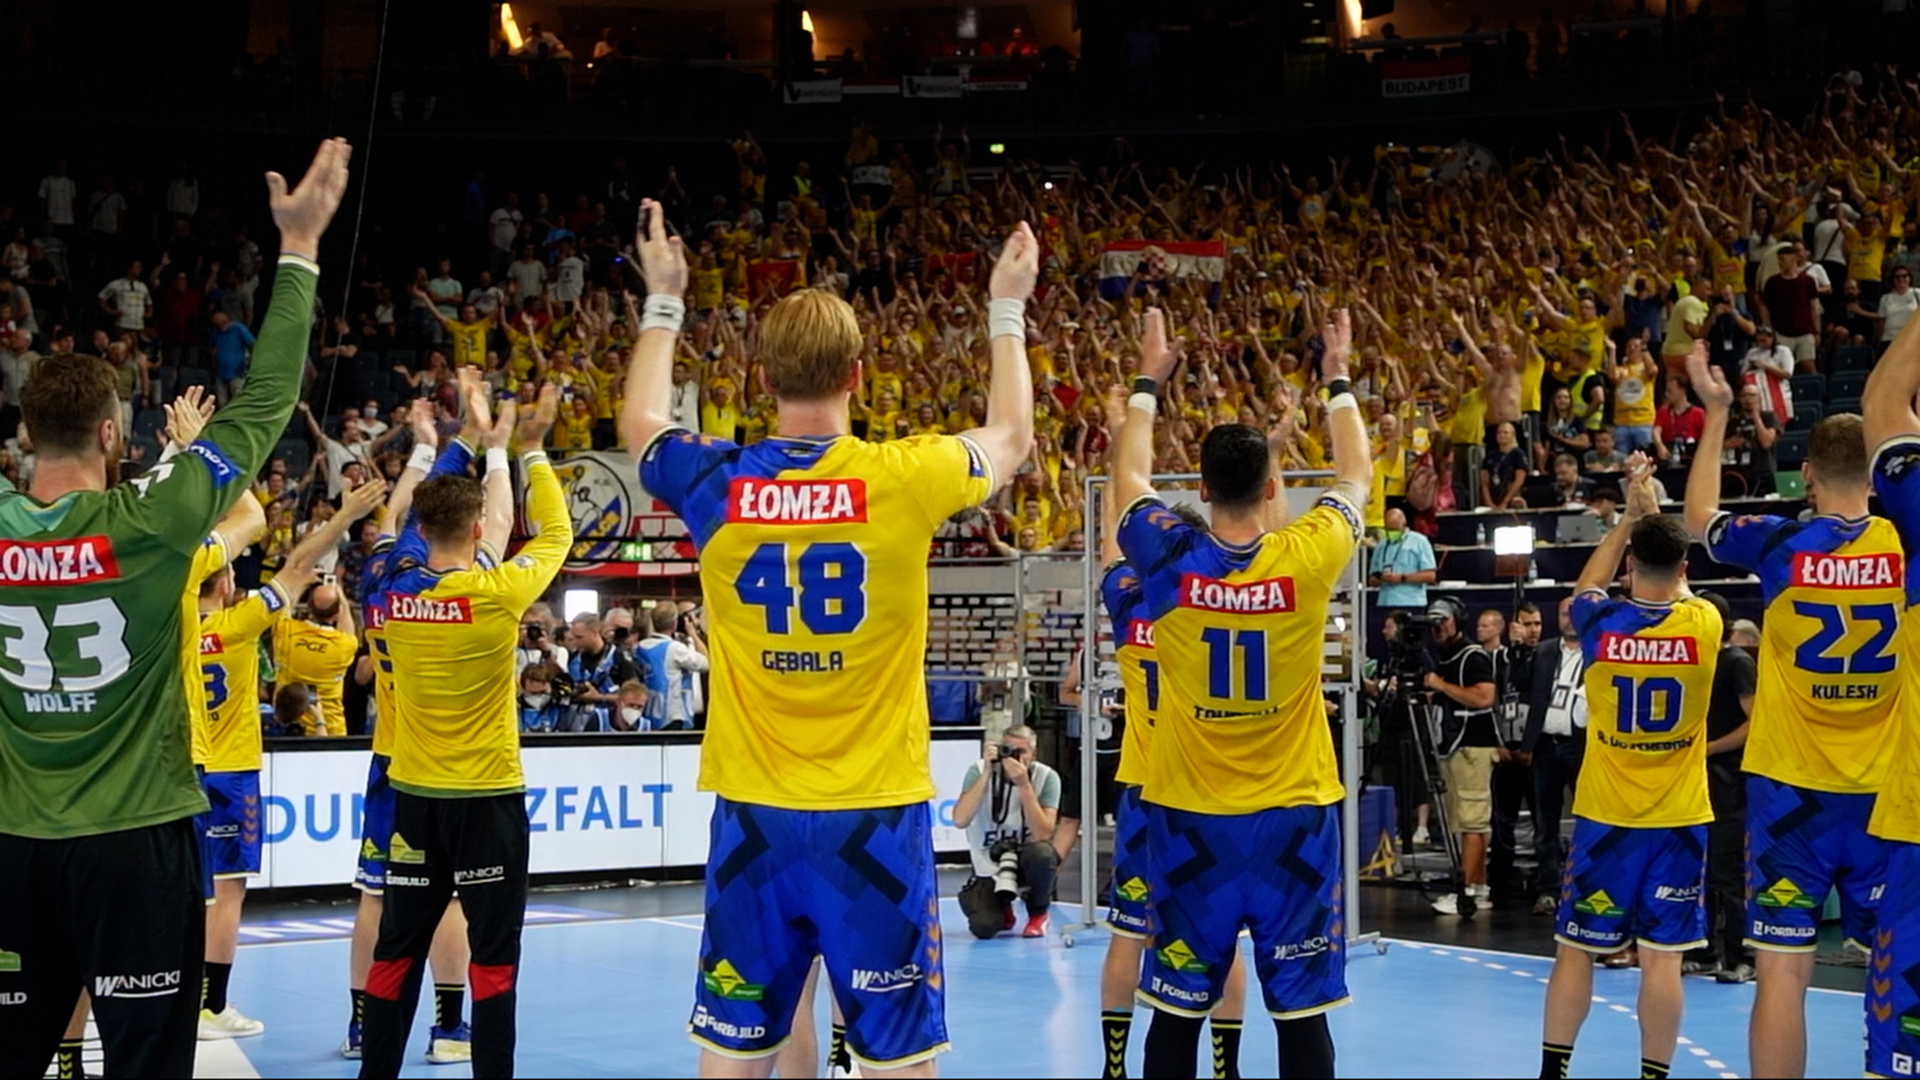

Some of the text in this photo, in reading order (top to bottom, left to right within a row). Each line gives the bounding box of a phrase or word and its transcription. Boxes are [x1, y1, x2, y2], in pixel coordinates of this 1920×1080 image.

[1385, 76, 1465, 94] BUDAPEST
[739, 482, 855, 520] ŁOMŻA
[1802, 556, 1893, 586] ŁOMŻA
[733, 541, 868, 636] 48
[1190, 577, 1287, 612] ŁOMŻA
[0, 597, 131, 692] 33
[1607, 636, 1689, 662] ŁOMŻA
[1792, 600, 1899, 675] 22
[762, 650, 843, 674] GĘBALA
[1200, 626, 1271, 702] 11
[1139, 659, 1159, 711] 1
[1812, 684, 1878, 699] KULESH
[23, 692, 97, 713] WOLFF
[1611, 674, 1684, 734] 10
[1764, 925, 1816, 937] FORBUILD
[95, 969, 181, 997] WANICKI
